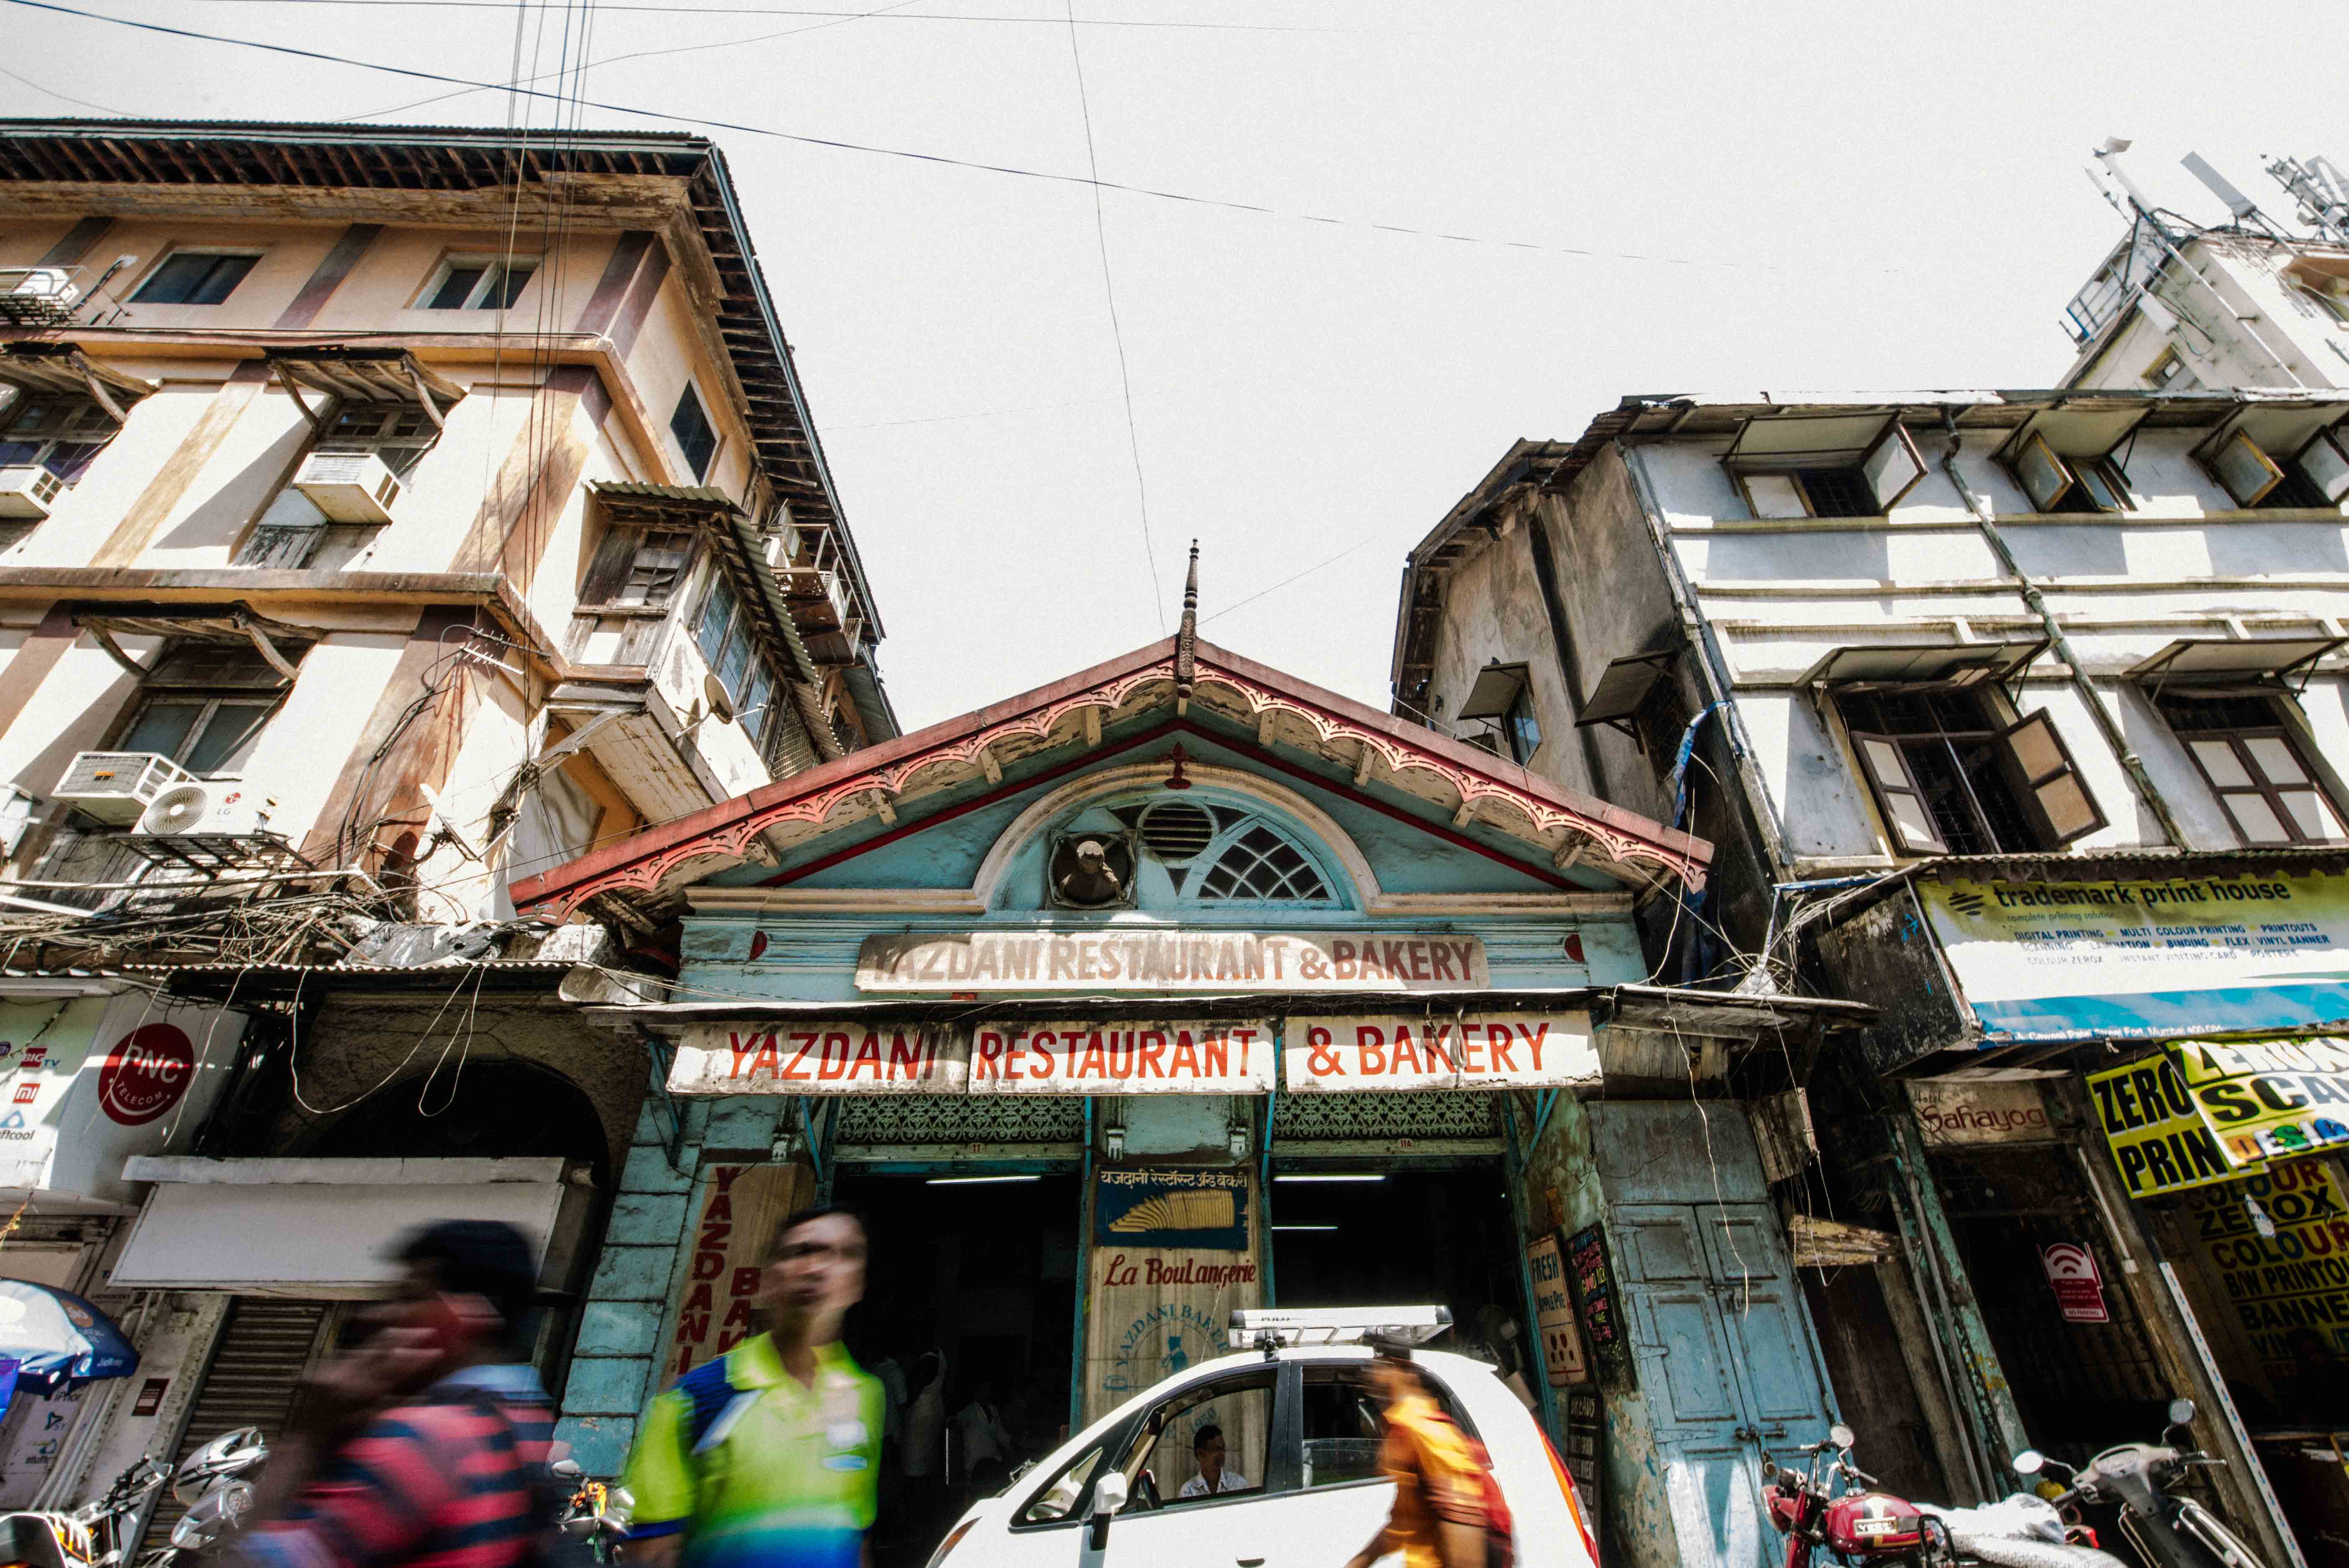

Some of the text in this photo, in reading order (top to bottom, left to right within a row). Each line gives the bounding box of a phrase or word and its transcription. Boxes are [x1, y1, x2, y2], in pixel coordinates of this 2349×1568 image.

[1993, 880, 2291, 909] trademark print house
[2013, 923, 2318, 940] DIGITAL PRINTING MULTI COLOUR PRINTING PRINTOUTS
[2048, 911, 2082, 922] printing
[871, 939, 1474, 981] YAZDANI RESTAURANT & BAKERY
[2020, 942, 2073, 953] SCANNING
[2167, 938, 2209, 949] BINDING
[2224, 936, 2250, 947] FLEX
[2256, 936, 2288, 946] VINYL
[2288, 935, 2331, 945] BANNER
[2027, 957, 2069, 966] COLOUR
[2071, 955, 2104, 965] ZEROX
[44, 1059, 61, 1067] TV
[119, 1044, 184, 1084] PNC
[729, 1029, 1257, 1081] YAZDANI RESTAURANT
[1306, 1022, 1550, 1078] & BAKERY
[117, 1081, 163, 1106] TELECOM
[1921, 1104, 2048, 1133] Sahayog
[2117, 1125, 2252, 1195] PRIN
[2184, 1161, 2327, 1211] COLOUR
[2211, 1221, 2349, 1269] COLOUR
[675, 1166, 739, 1375] YAZDANI
[1103, 1254, 1139, 1286] La
[1531, 1251, 1560, 1285] FRESH
[2222, 1269, 2262, 1298] B/W
[2237, 1292, 2349, 1331] BANNE
[1116, 1304, 1174, 1366] YAZDANI
